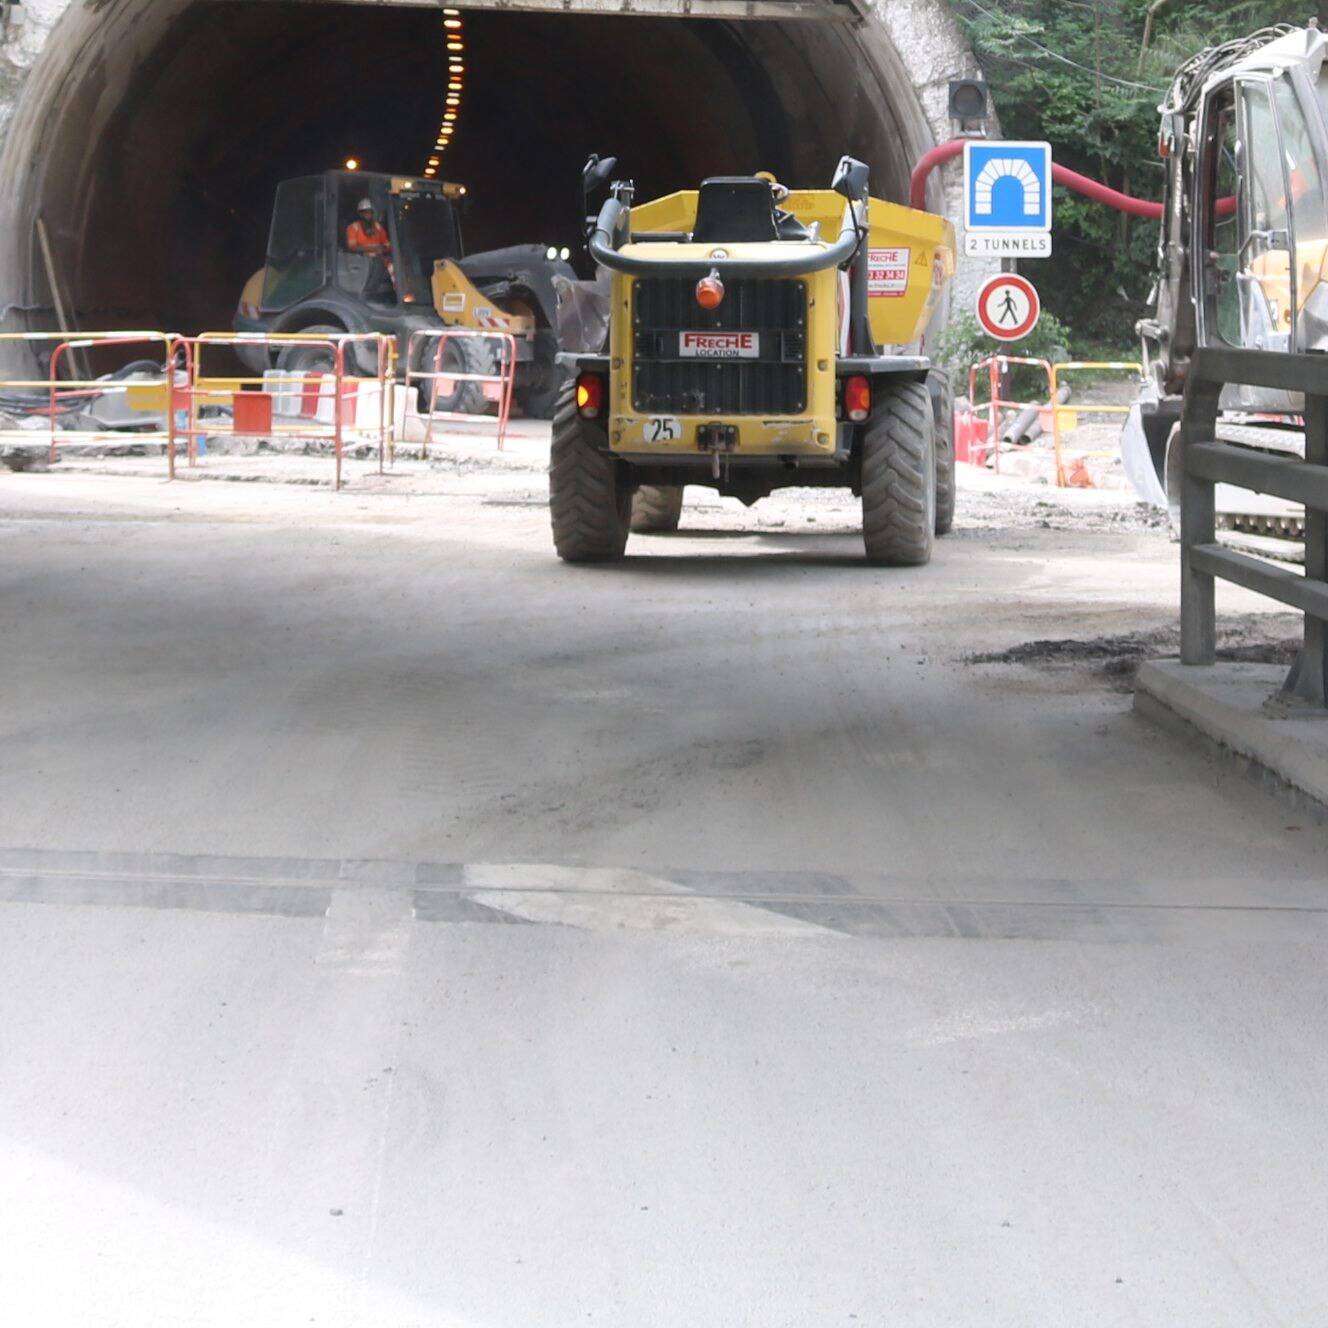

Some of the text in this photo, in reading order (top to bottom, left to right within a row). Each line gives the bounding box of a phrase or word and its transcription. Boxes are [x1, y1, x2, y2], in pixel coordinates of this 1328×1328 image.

[970, 238, 1047, 250] 2 TUNNELS
[684, 332, 753, 349] FRECHE
[695, 348, 740, 358] LOCATION
[650, 418, 675, 443] 25
